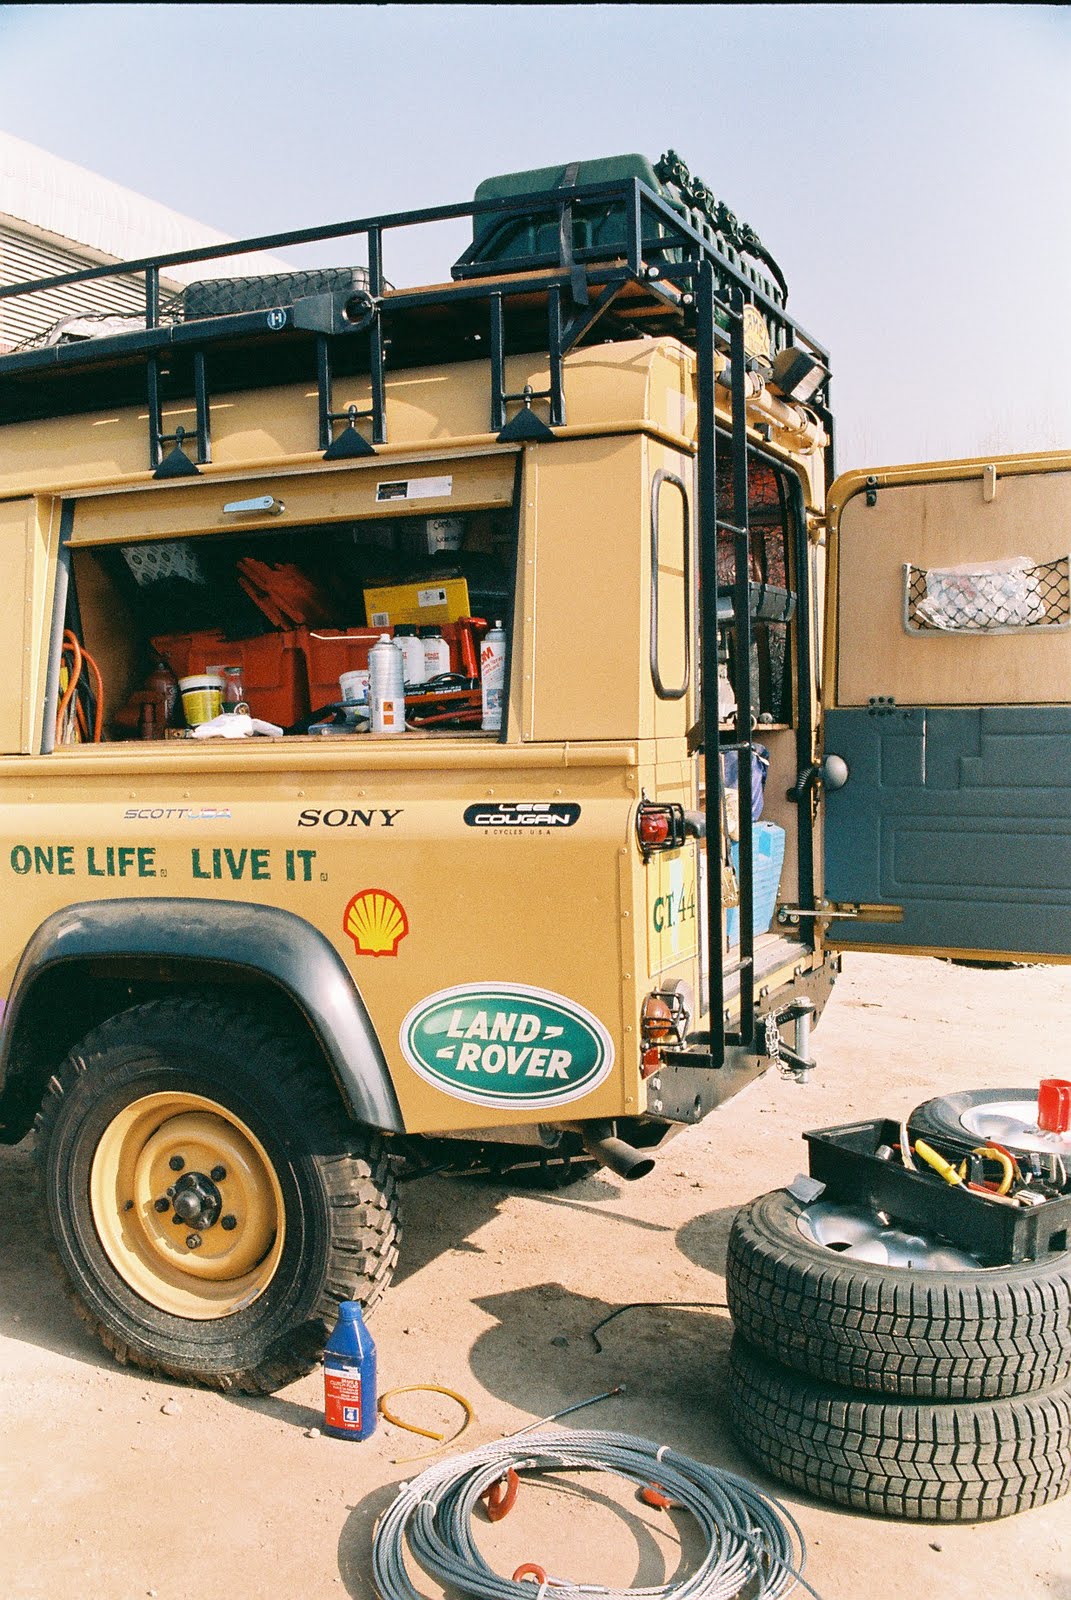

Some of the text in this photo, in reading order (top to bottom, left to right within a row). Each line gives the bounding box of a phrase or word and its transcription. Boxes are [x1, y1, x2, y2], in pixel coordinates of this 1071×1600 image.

[298, 809, 404, 827] SONY
[475, 814, 571, 825] COUGAN
[498, 803, 551, 812] LEE
[10, 844, 75, 875] ONE
[191, 847, 272, 880] LIVE
[446, 1009, 542, 1043] LAND
[455, 1042, 573, 1079] ROVER
